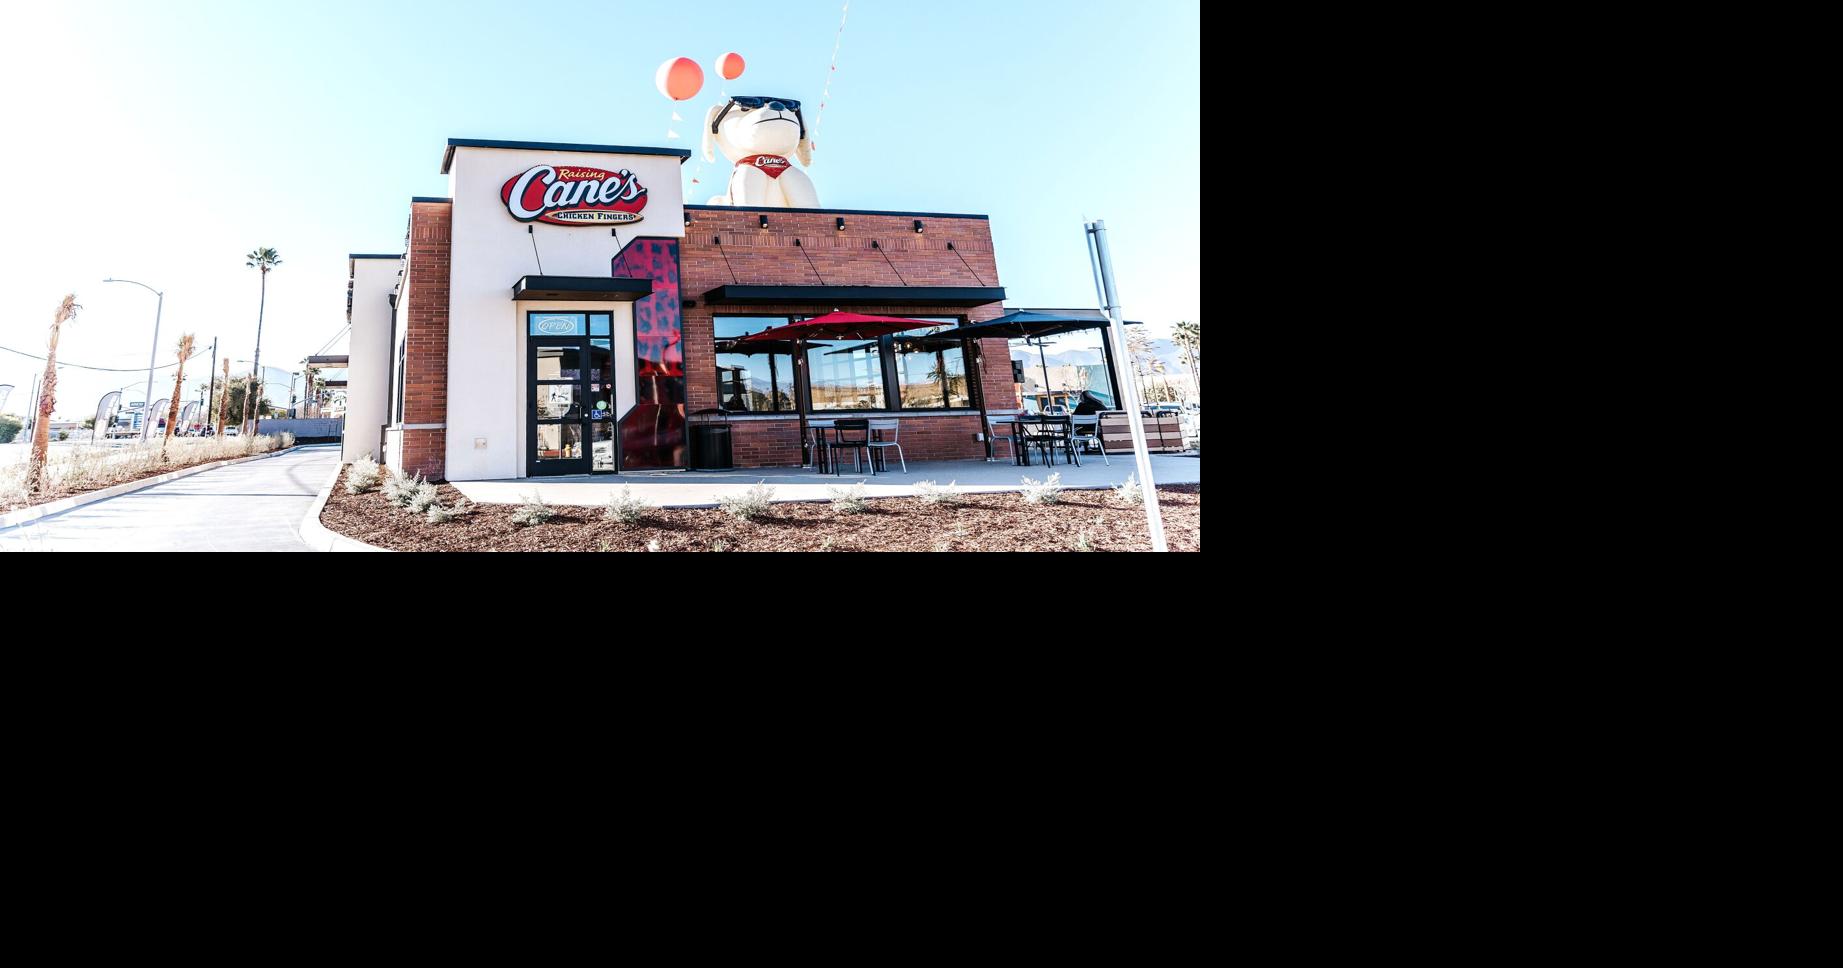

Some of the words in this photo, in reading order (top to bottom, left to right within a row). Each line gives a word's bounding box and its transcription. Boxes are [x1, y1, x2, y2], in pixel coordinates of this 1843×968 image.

[755, 155, 785, 166] Cane
[559, 169, 605, 180] Raising
[509, 164, 647, 221] Cane's
[557, 211, 595, 220] CHICKEN
[597, 212, 634, 221] FINGERS
[541, 321, 571, 330] OPEN
